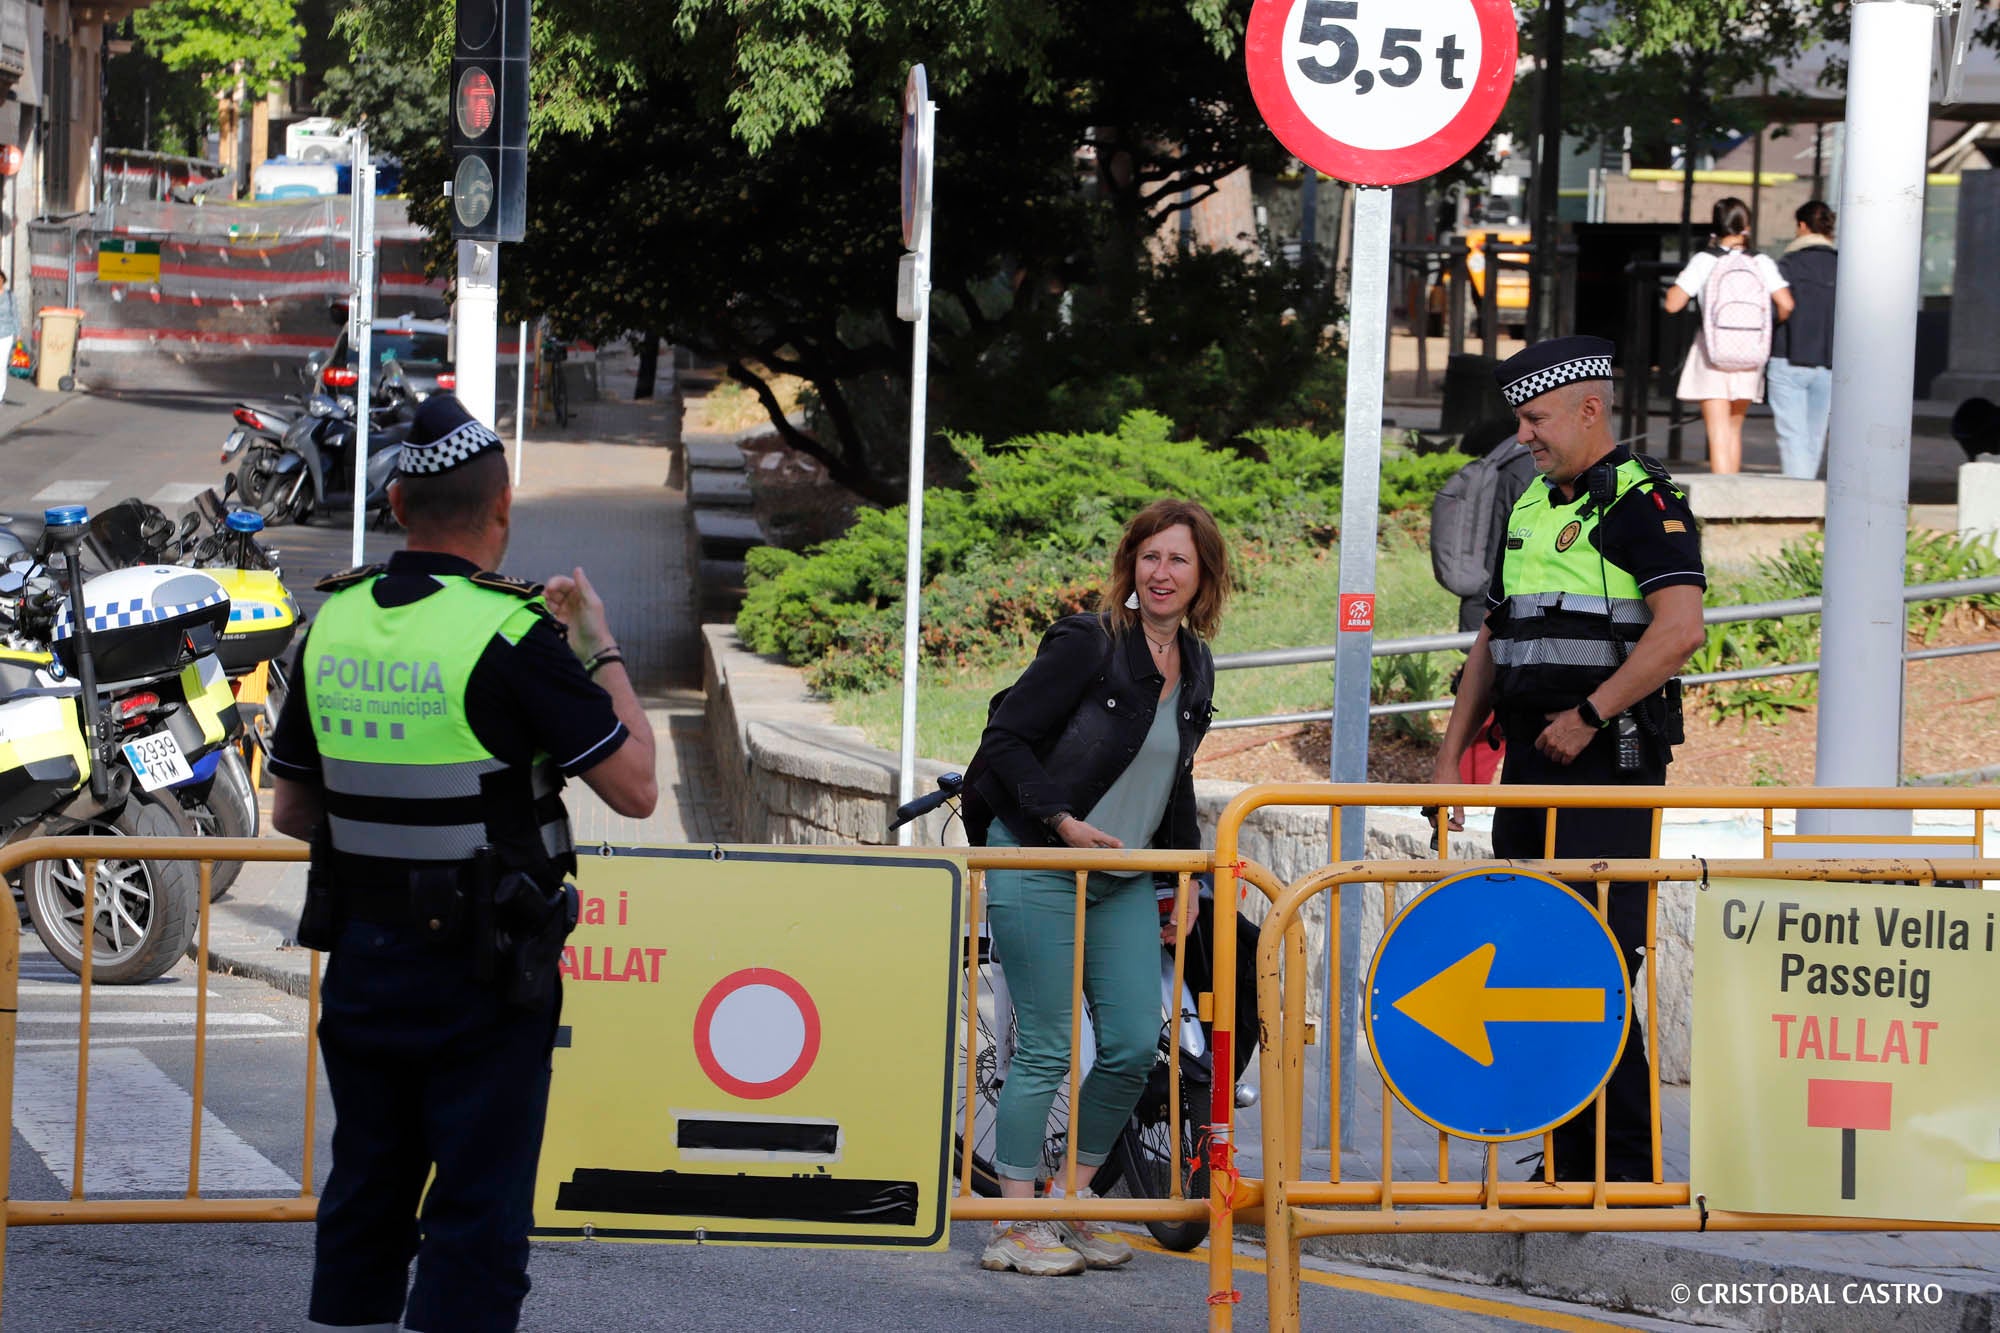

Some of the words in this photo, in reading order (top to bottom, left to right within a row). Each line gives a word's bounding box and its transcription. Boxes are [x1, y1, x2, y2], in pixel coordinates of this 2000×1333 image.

[1297, 0, 1422, 95] 5,5
[1436, 34, 1465, 90] t
[316, 654, 445, 694] POLICIA
[367, 697, 447, 720] municipal
[137, 736, 176, 763] 2939
[146, 758, 180, 784] KTM
[618, 890, 628, 925] i
[1722, 899, 1765, 945] C/
[1777, 902, 1861, 945] Font
[1874, 906, 1970, 951] Vella
[1985, 912, 1995, 952] i
[1780, 953, 1931, 1009] Passeig
[1771, 1013, 1939, 1065] TALLAT
